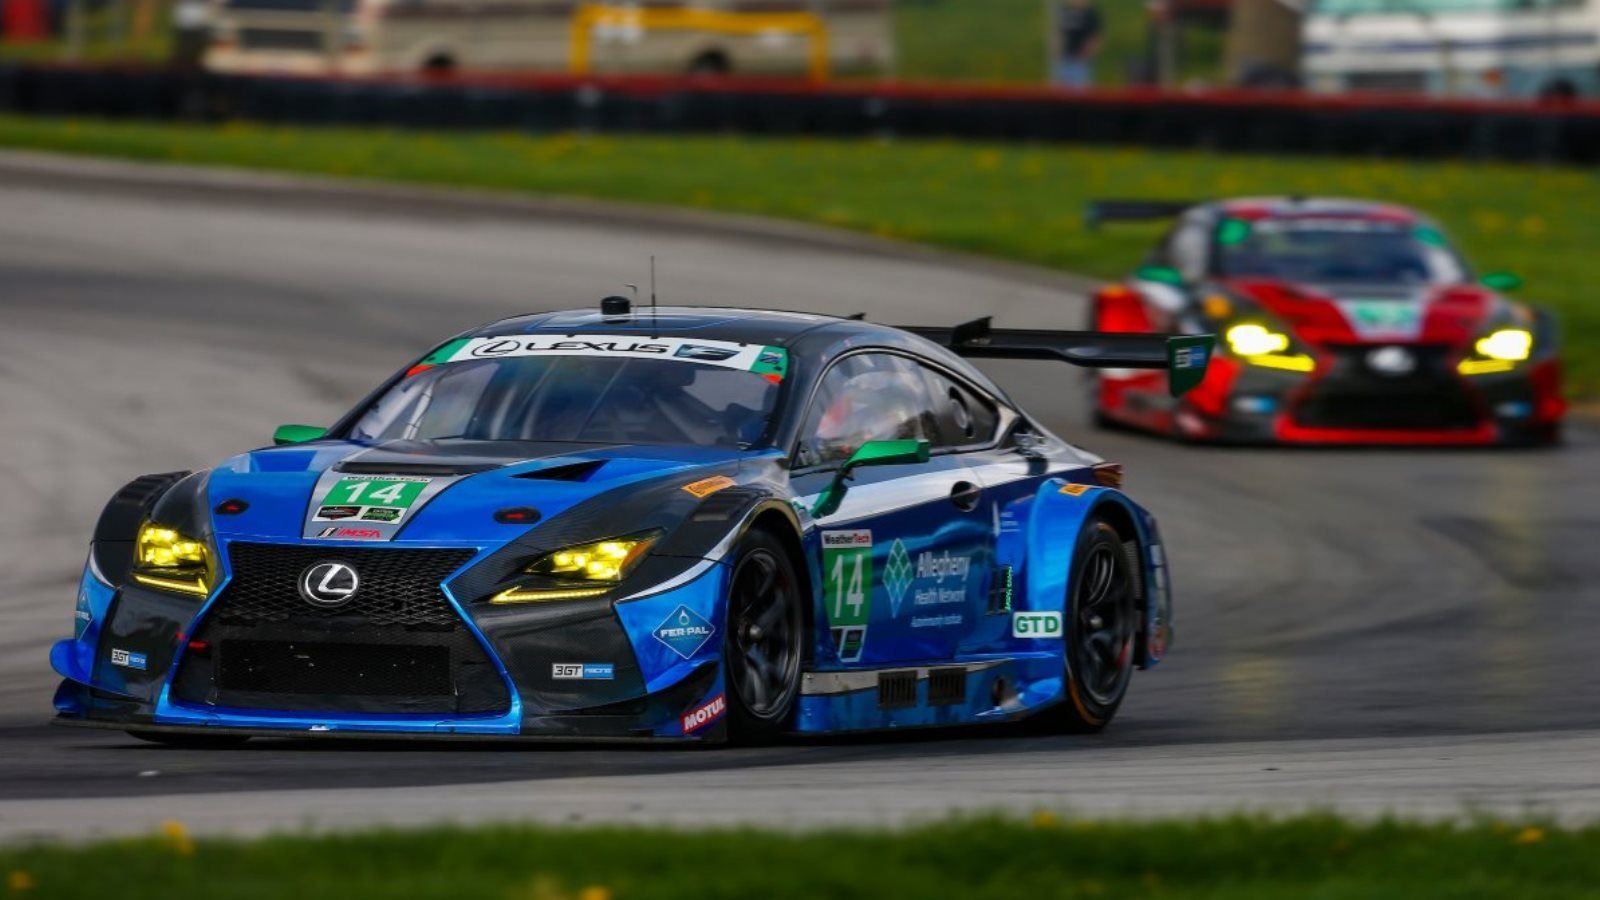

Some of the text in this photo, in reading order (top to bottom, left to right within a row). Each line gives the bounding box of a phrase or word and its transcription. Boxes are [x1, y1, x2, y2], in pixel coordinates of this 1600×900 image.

[525, 342, 670, 355] LEXUS
[345, 481, 407, 504] 14
[337, 528, 382, 539] IMSA
[823, 533, 870, 545] WeatherTech
[916, 550, 972, 583] Allegheny
[831, 553, 865, 619] 14
[1015, 616, 1060, 633] GTD
[554, 665, 582, 676] 3GT
[684, 697, 725, 730] MOTUL
